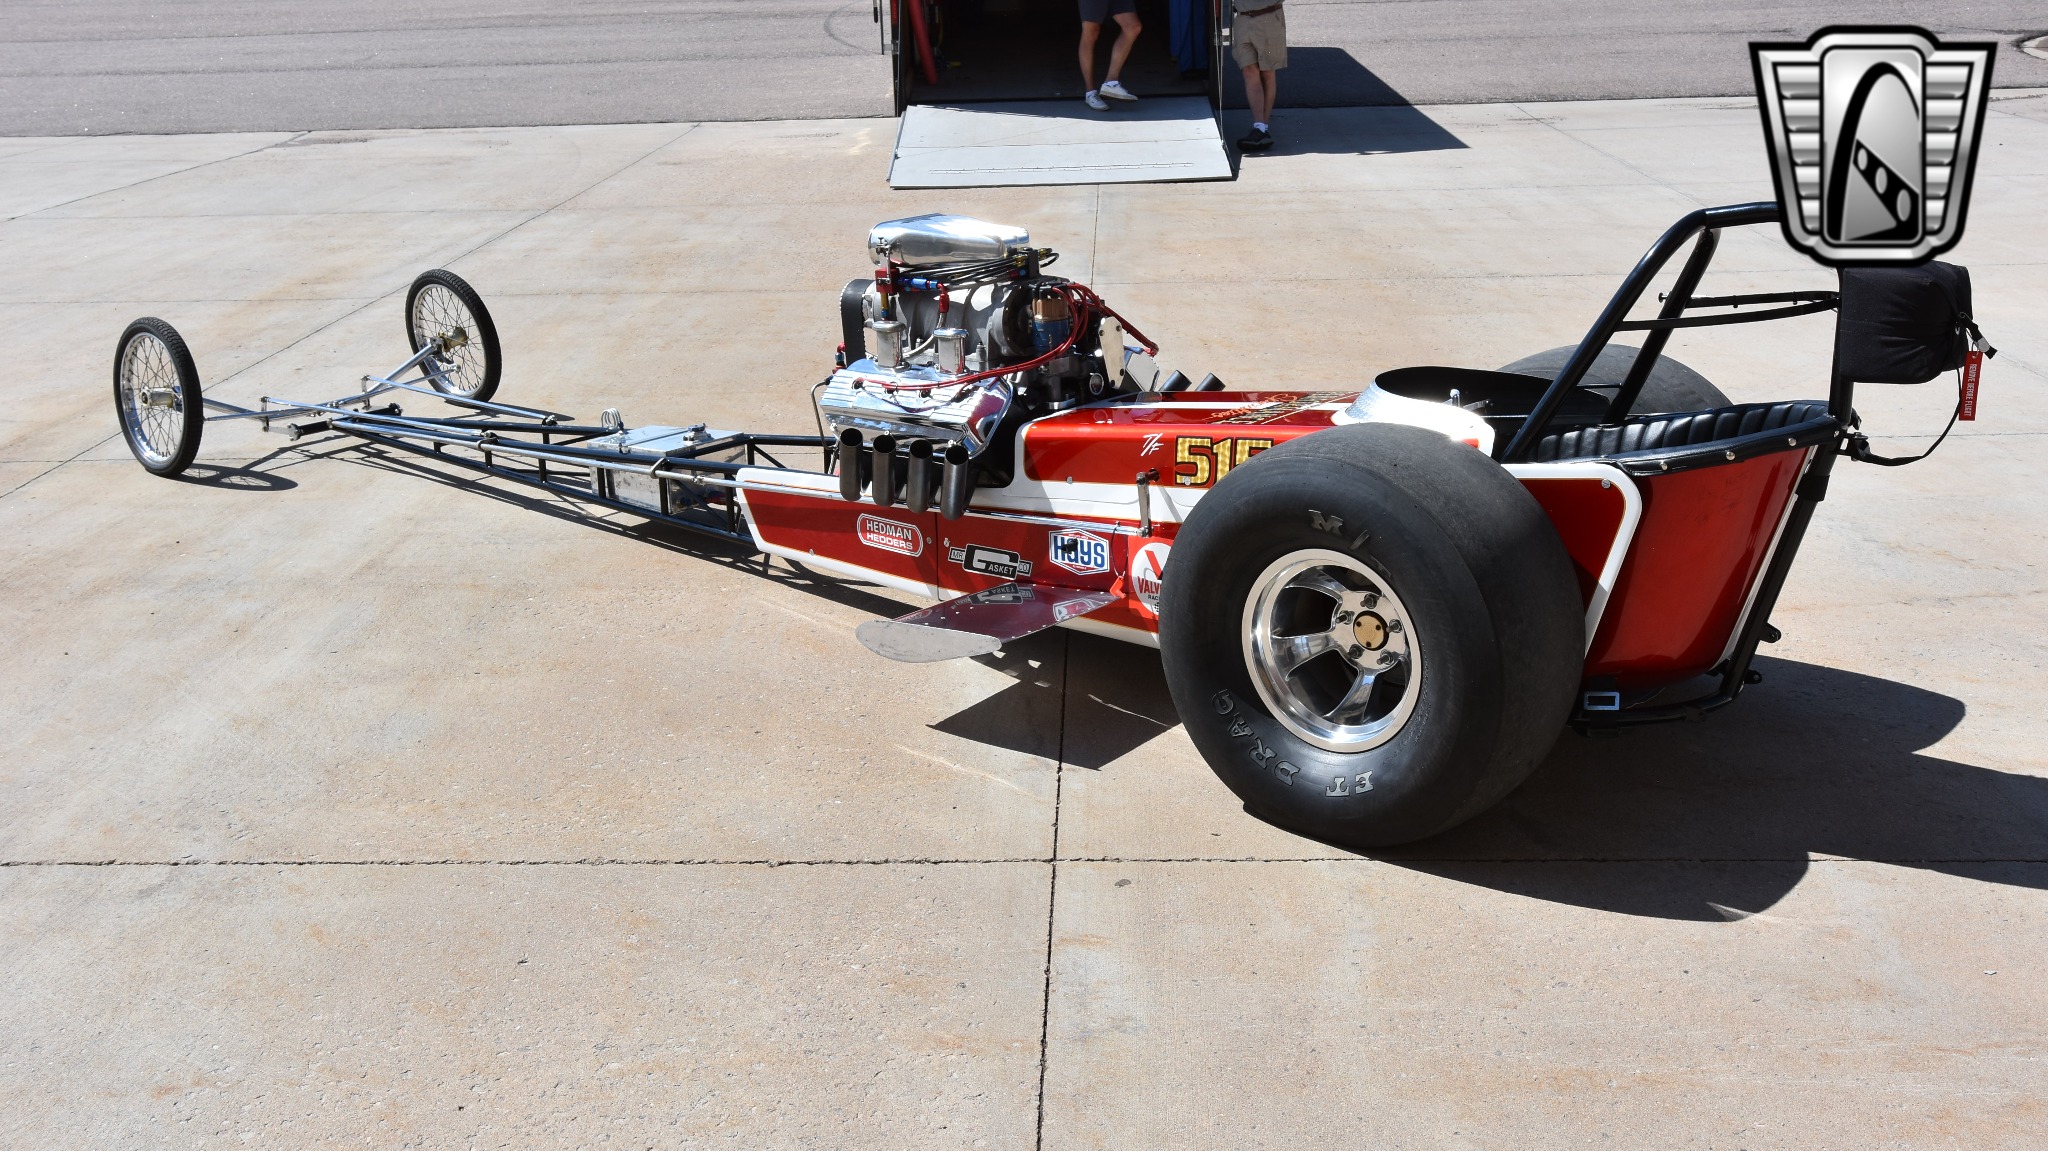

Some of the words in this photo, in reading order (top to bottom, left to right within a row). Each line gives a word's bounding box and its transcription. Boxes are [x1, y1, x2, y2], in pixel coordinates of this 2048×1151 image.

[1966, 383, 1975, 400] BEFORE
[866, 519, 913, 541] HEDMAN
[866, 532, 914, 551] HEDDERS
[1212, 689, 1301, 787] DRAG
[1325, 770, 1374, 798] ET
